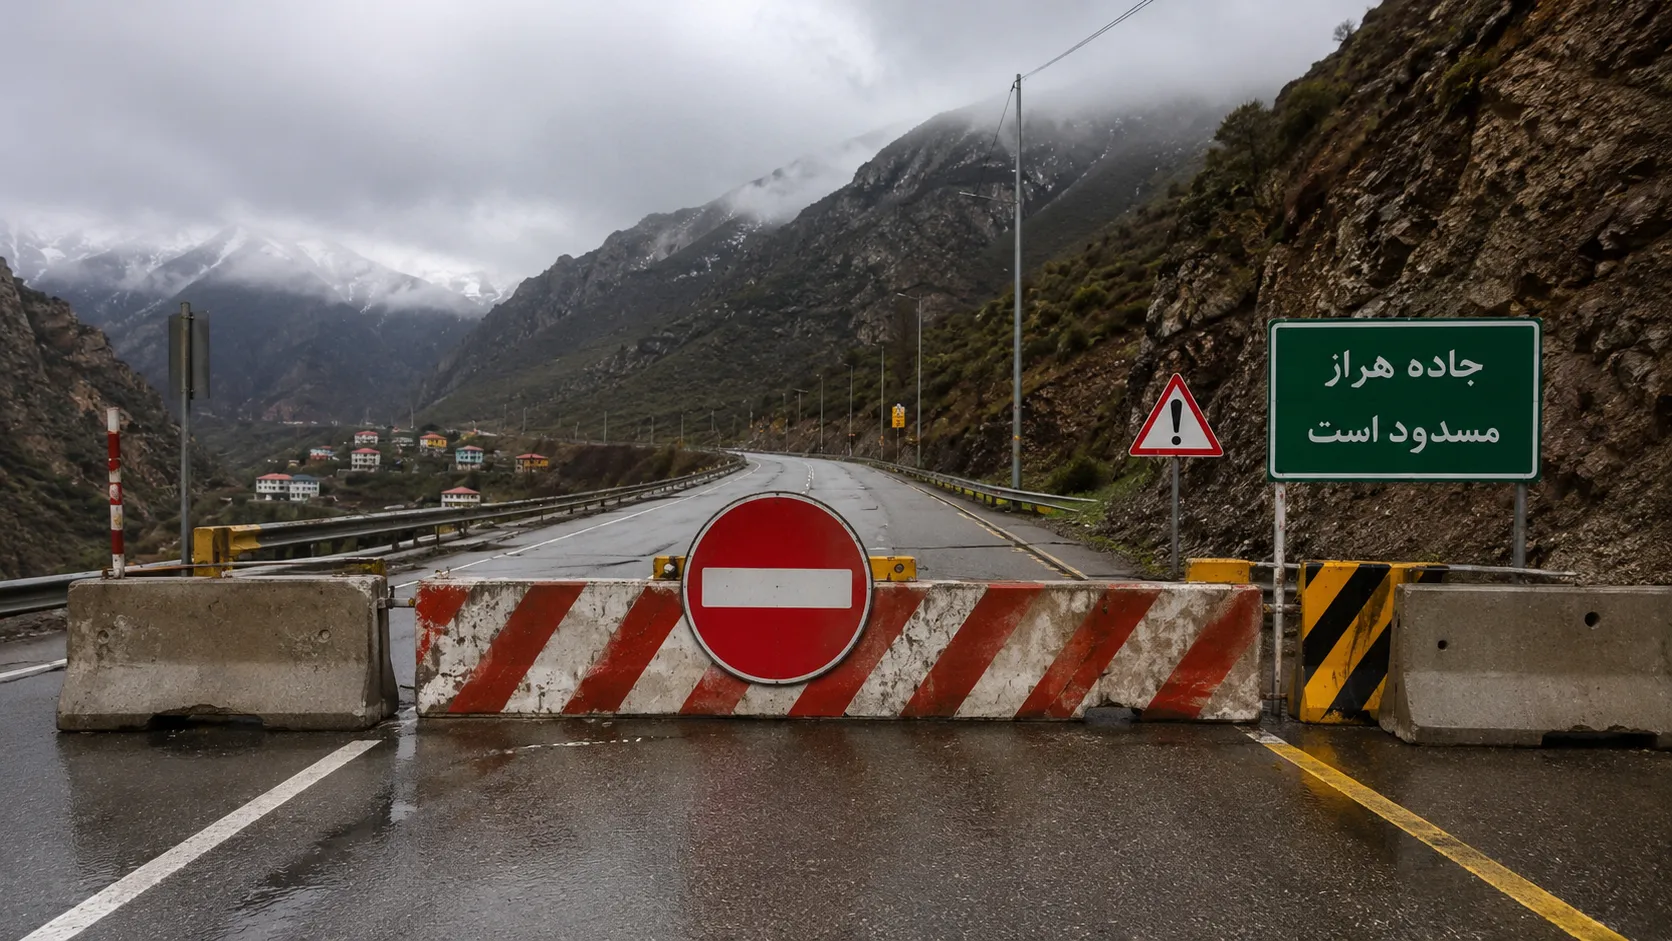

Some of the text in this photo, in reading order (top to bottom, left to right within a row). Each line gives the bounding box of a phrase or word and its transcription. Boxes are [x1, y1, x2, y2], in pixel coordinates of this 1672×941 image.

[1324, 349, 1484, 388] جاده هراز
[1308, 415, 1500, 454] مسدود است
